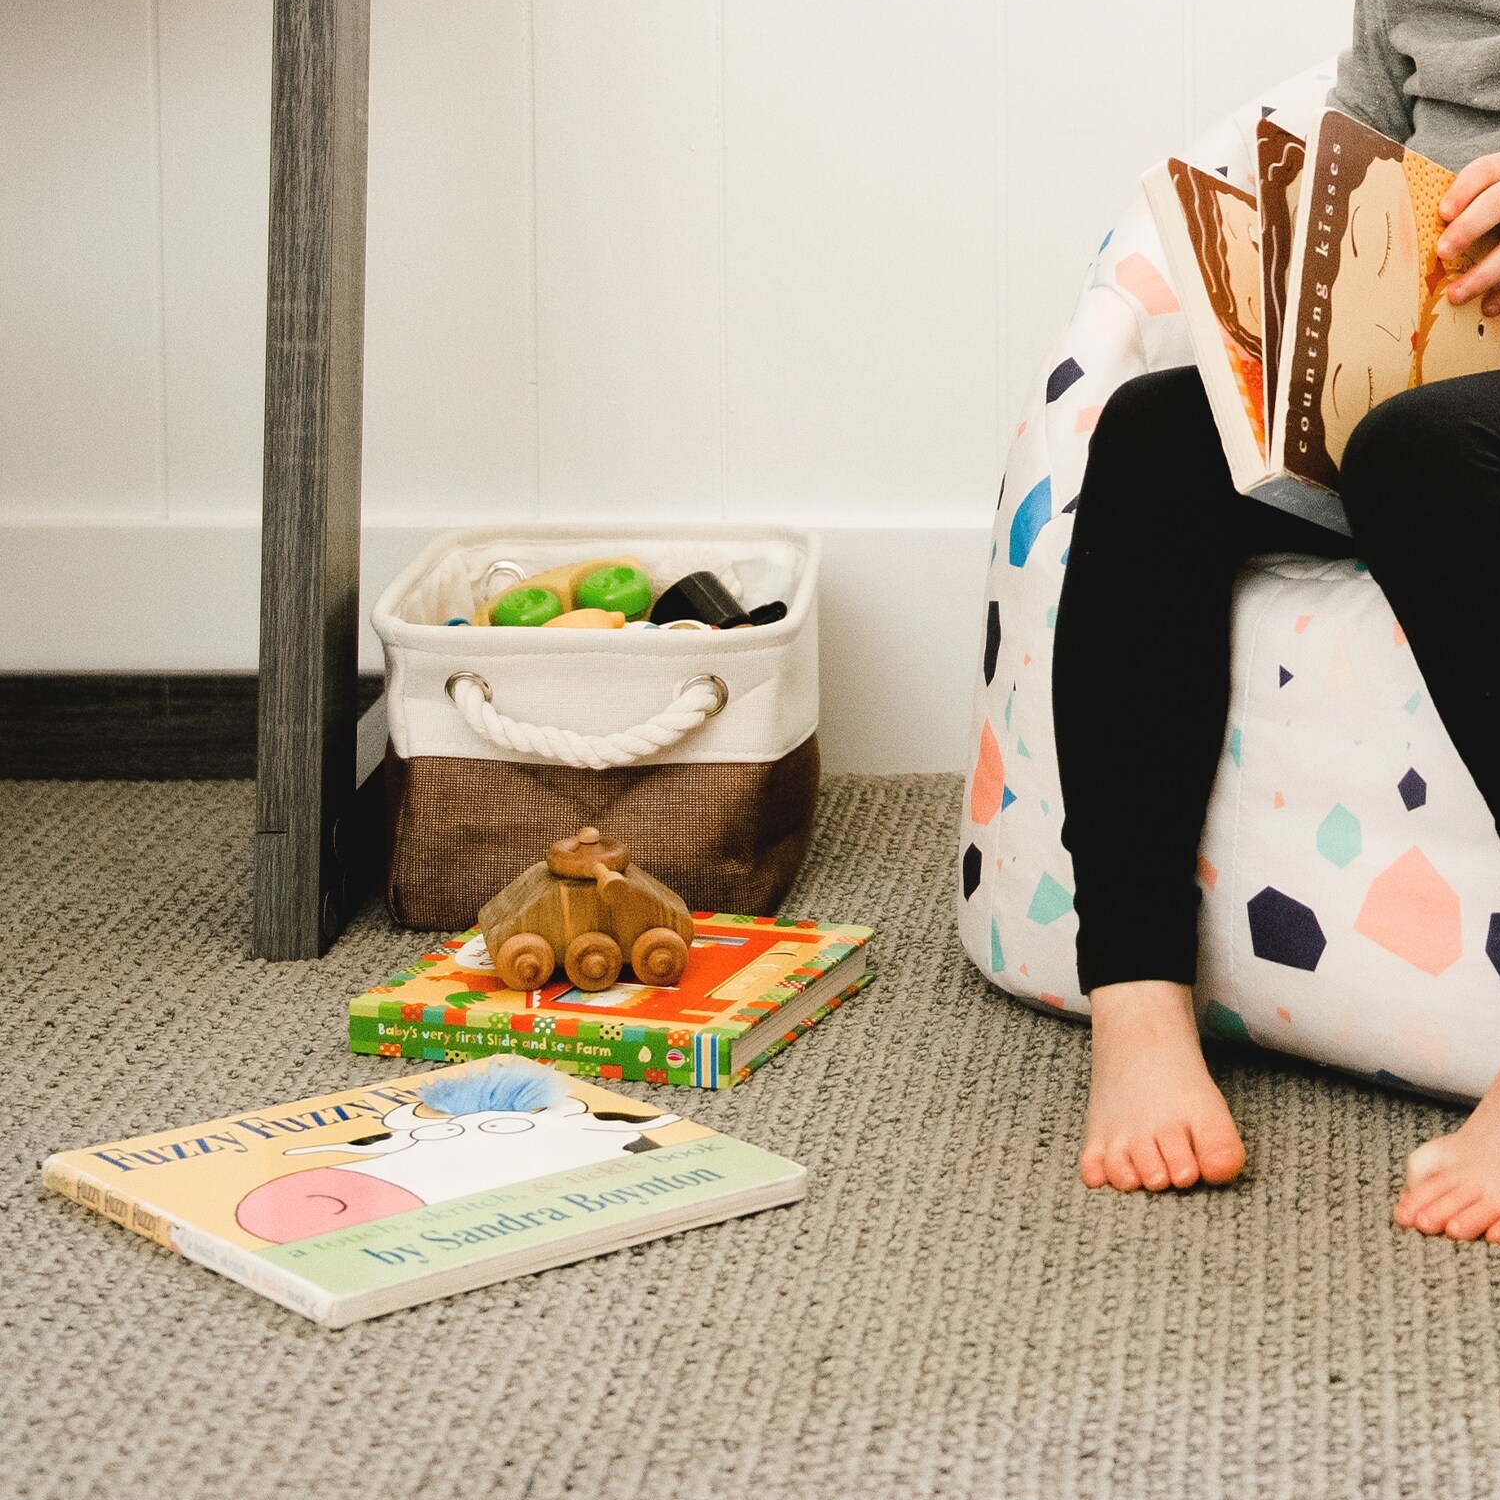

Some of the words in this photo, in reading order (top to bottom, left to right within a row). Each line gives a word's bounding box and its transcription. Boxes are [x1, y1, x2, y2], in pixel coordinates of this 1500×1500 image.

[1299, 282, 1329, 453] counting
[1315, 143, 1341, 258] kisses
[378, 1022, 417, 1041] Baby's
[421, 1030, 452, 1045] very
[455, 1030, 484, 1044] first
[486, 1033, 518, 1047] Slide
[522, 1037, 547, 1050] and
[550, 1041, 572, 1052] see
[576, 1041, 612, 1057] Farm
[87, 1131, 248, 1172] Fuzzy
[232, 1100, 384, 1140] Fuzzy
[288, 1248, 308, 1258] a
[564, 1161, 646, 1184] tickle
[646, 1141, 725, 1164] book
[360, 1243, 430, 1266] by
[419, 1206, 572, 1250] Sandra
[559, 1167, 726, 1214] Boynton
